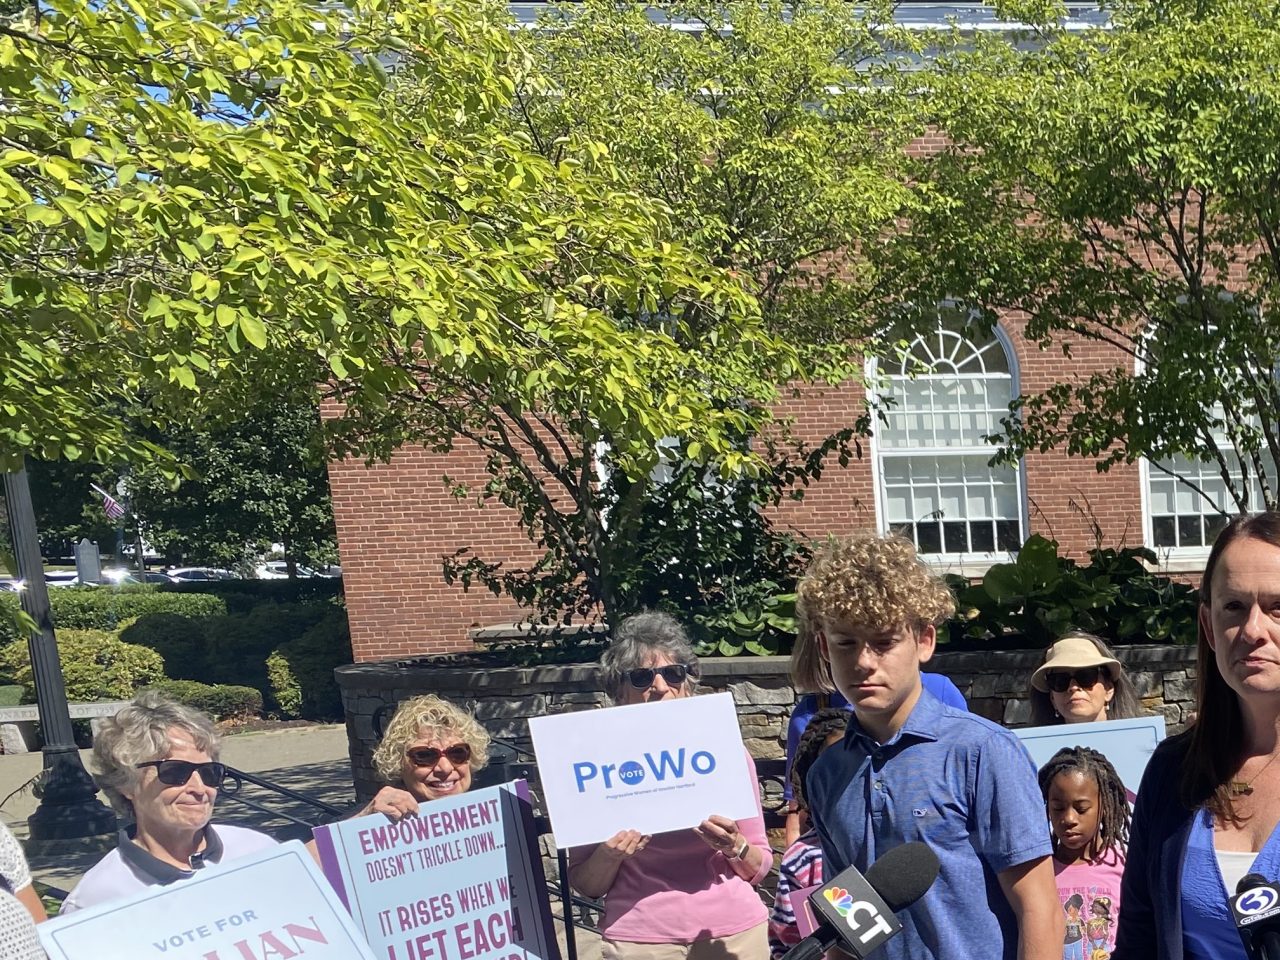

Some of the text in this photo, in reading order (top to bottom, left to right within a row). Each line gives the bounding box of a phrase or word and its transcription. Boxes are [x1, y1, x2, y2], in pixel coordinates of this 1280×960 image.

[619, 769, 644, 780] VOTE
[358, 799, 500, 855] EMPOWERMENT
[366, 831, 507, 883] DOESN'T TRICKLE DOWN...
[378, 875, 518, 937] IT RISES WHEN WE
[846, 901, 893, 944] CT
[1240, 889, 1274, 913] 3
[152, 909, 258, 952] VOTE FOR
[454, 906, 524, 960] EACH
